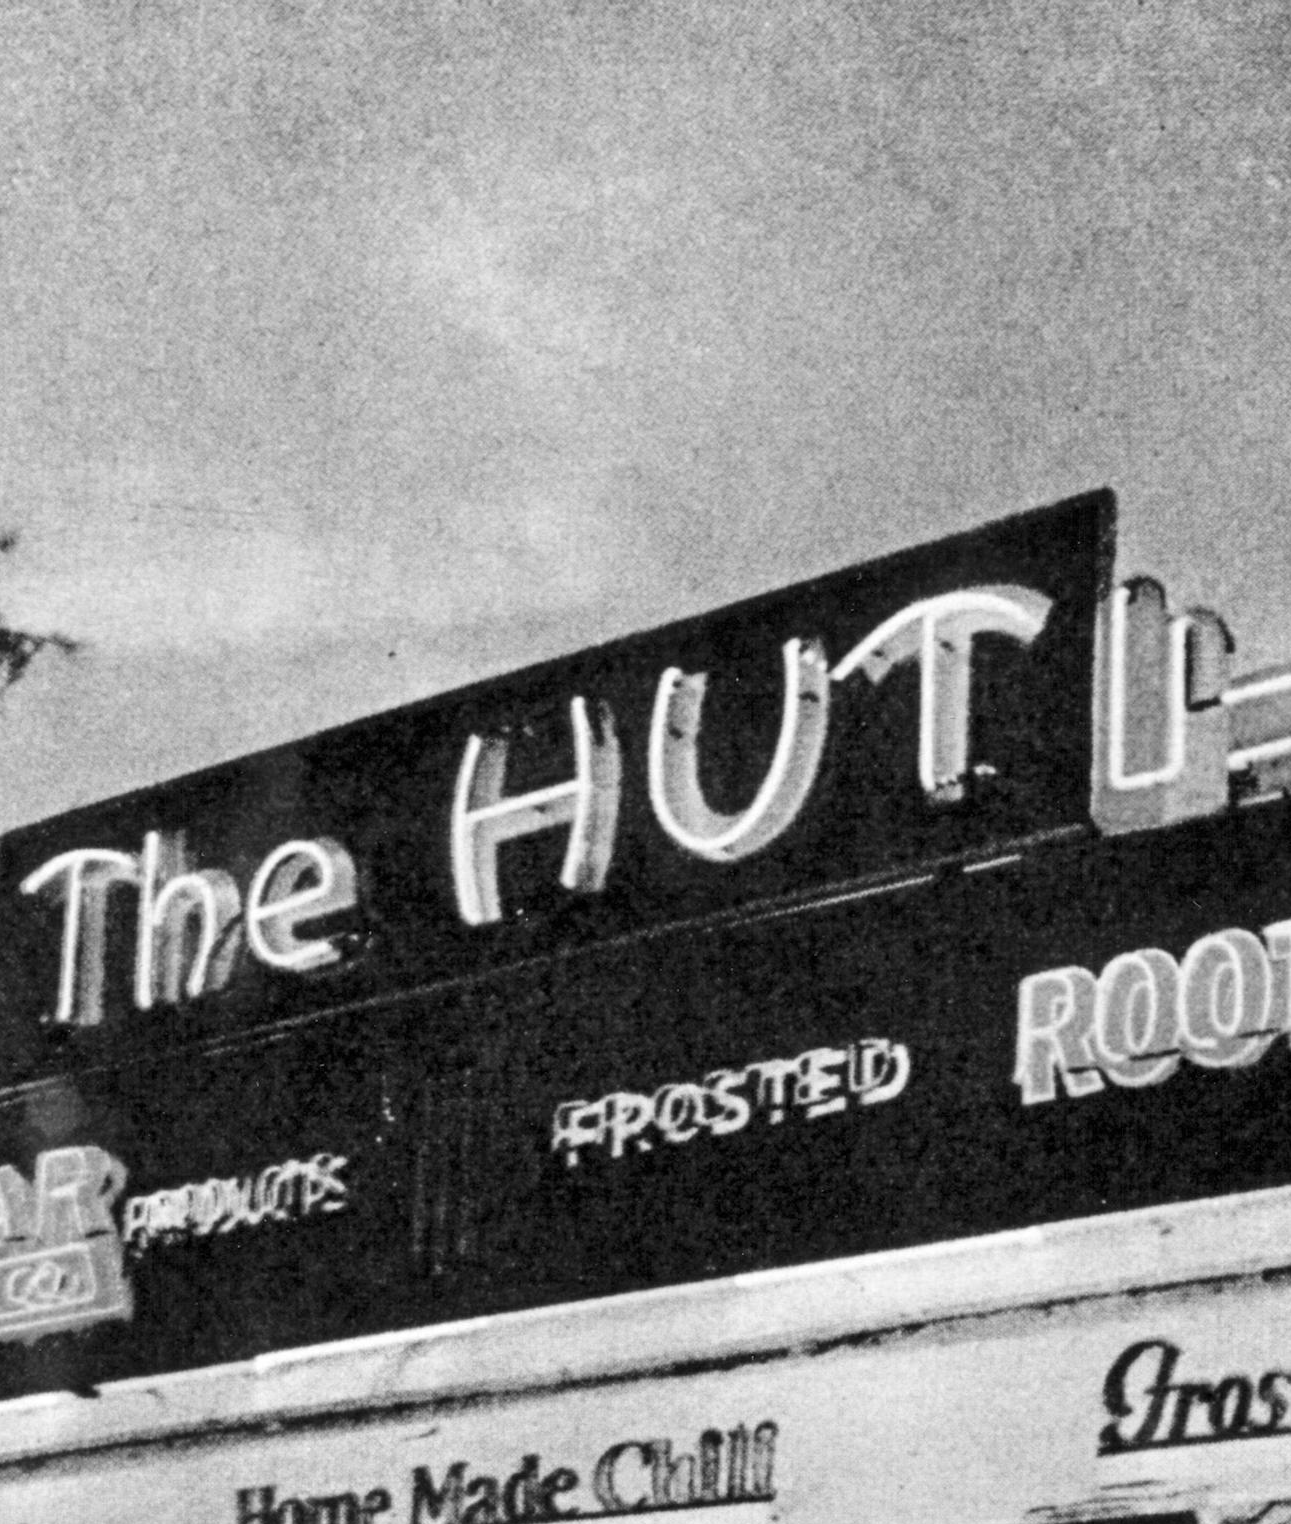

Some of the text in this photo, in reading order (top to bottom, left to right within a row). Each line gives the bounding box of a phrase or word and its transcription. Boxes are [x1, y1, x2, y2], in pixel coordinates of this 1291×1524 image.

[19, 588, 1053, 1028] The HUT
[552, 1038, 912, 1166] FROSTED
